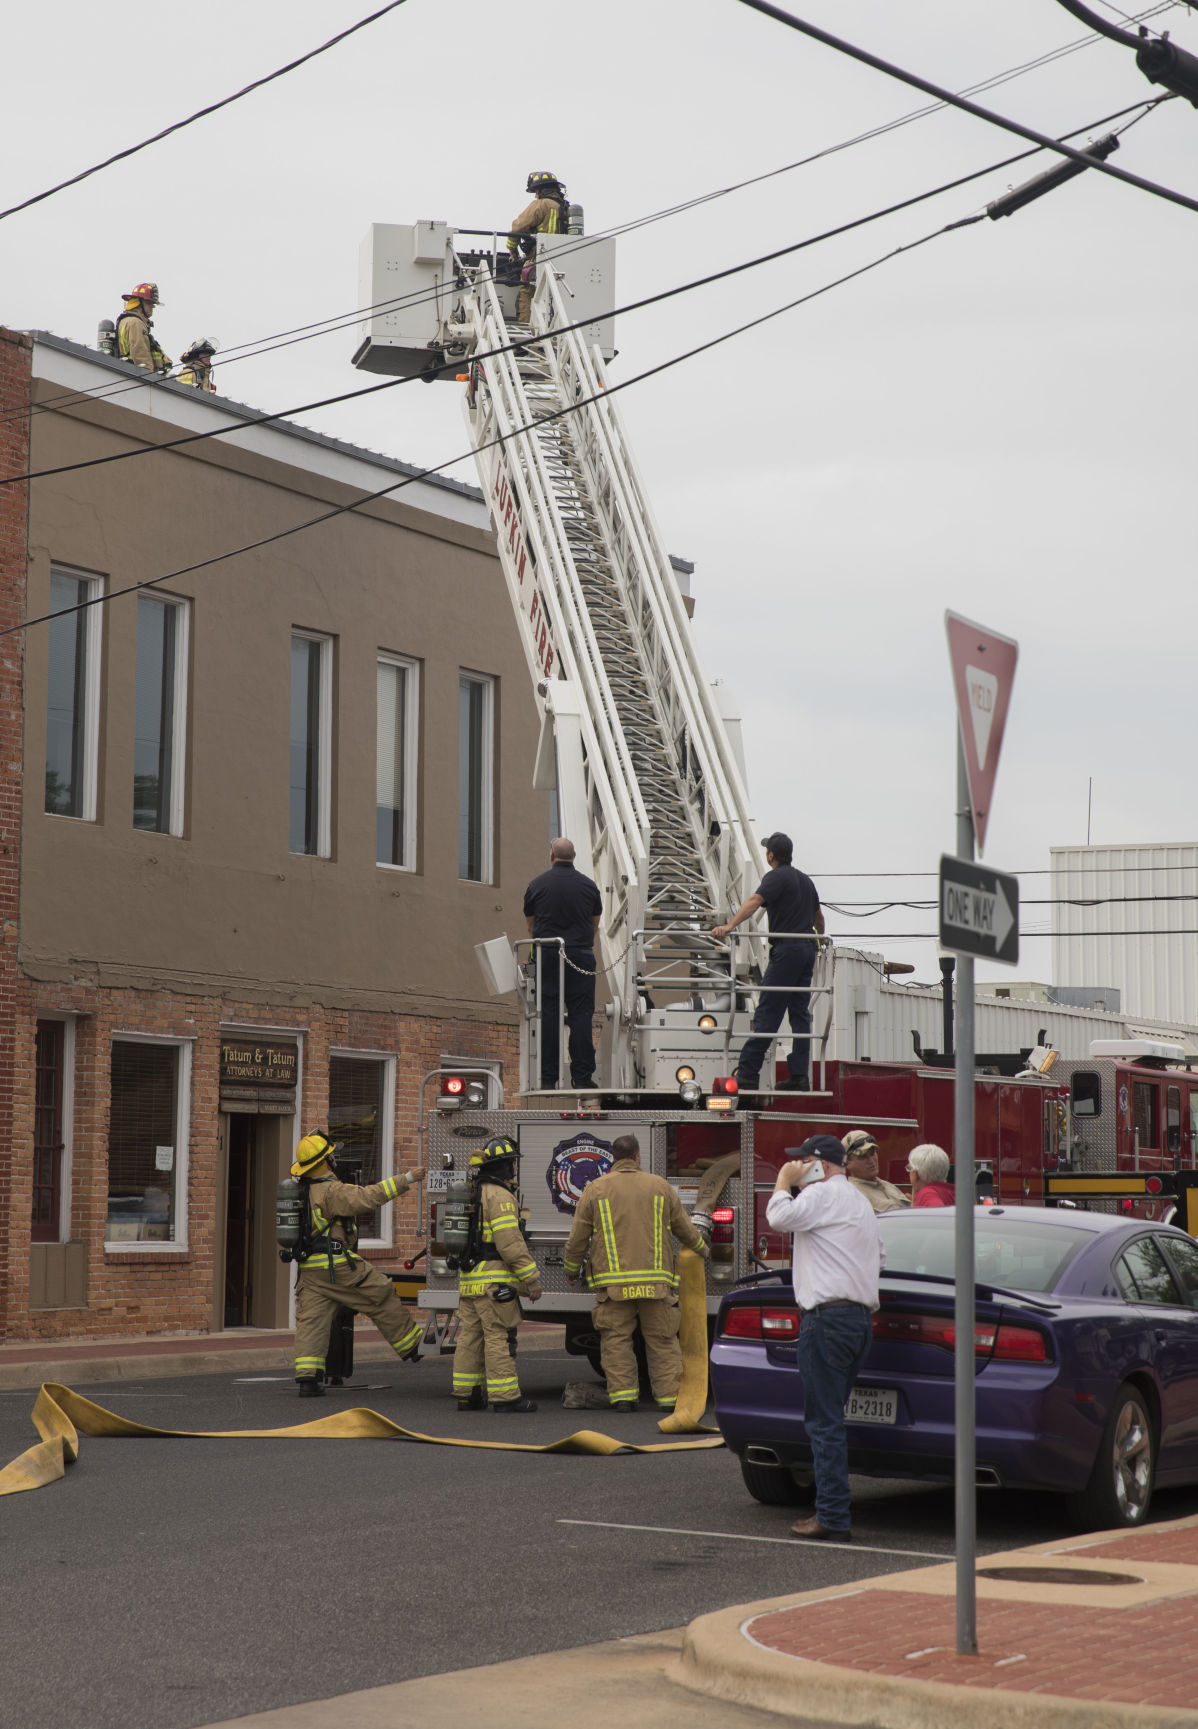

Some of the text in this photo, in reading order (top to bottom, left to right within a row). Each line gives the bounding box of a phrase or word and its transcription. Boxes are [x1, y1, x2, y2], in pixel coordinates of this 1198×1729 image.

[495, 461, 554, 679] LUFKIN FIRE
[970, 682, 993, 712] YIELD
[947, 887, 995, 932] ONE WAY
[223, 1046, 295, 1067] Tatum & Tatum
[226, 1066, 291, 1079] ATTORNEYS AT LAW
[854, 1389, 879, 1397] TEXAS
